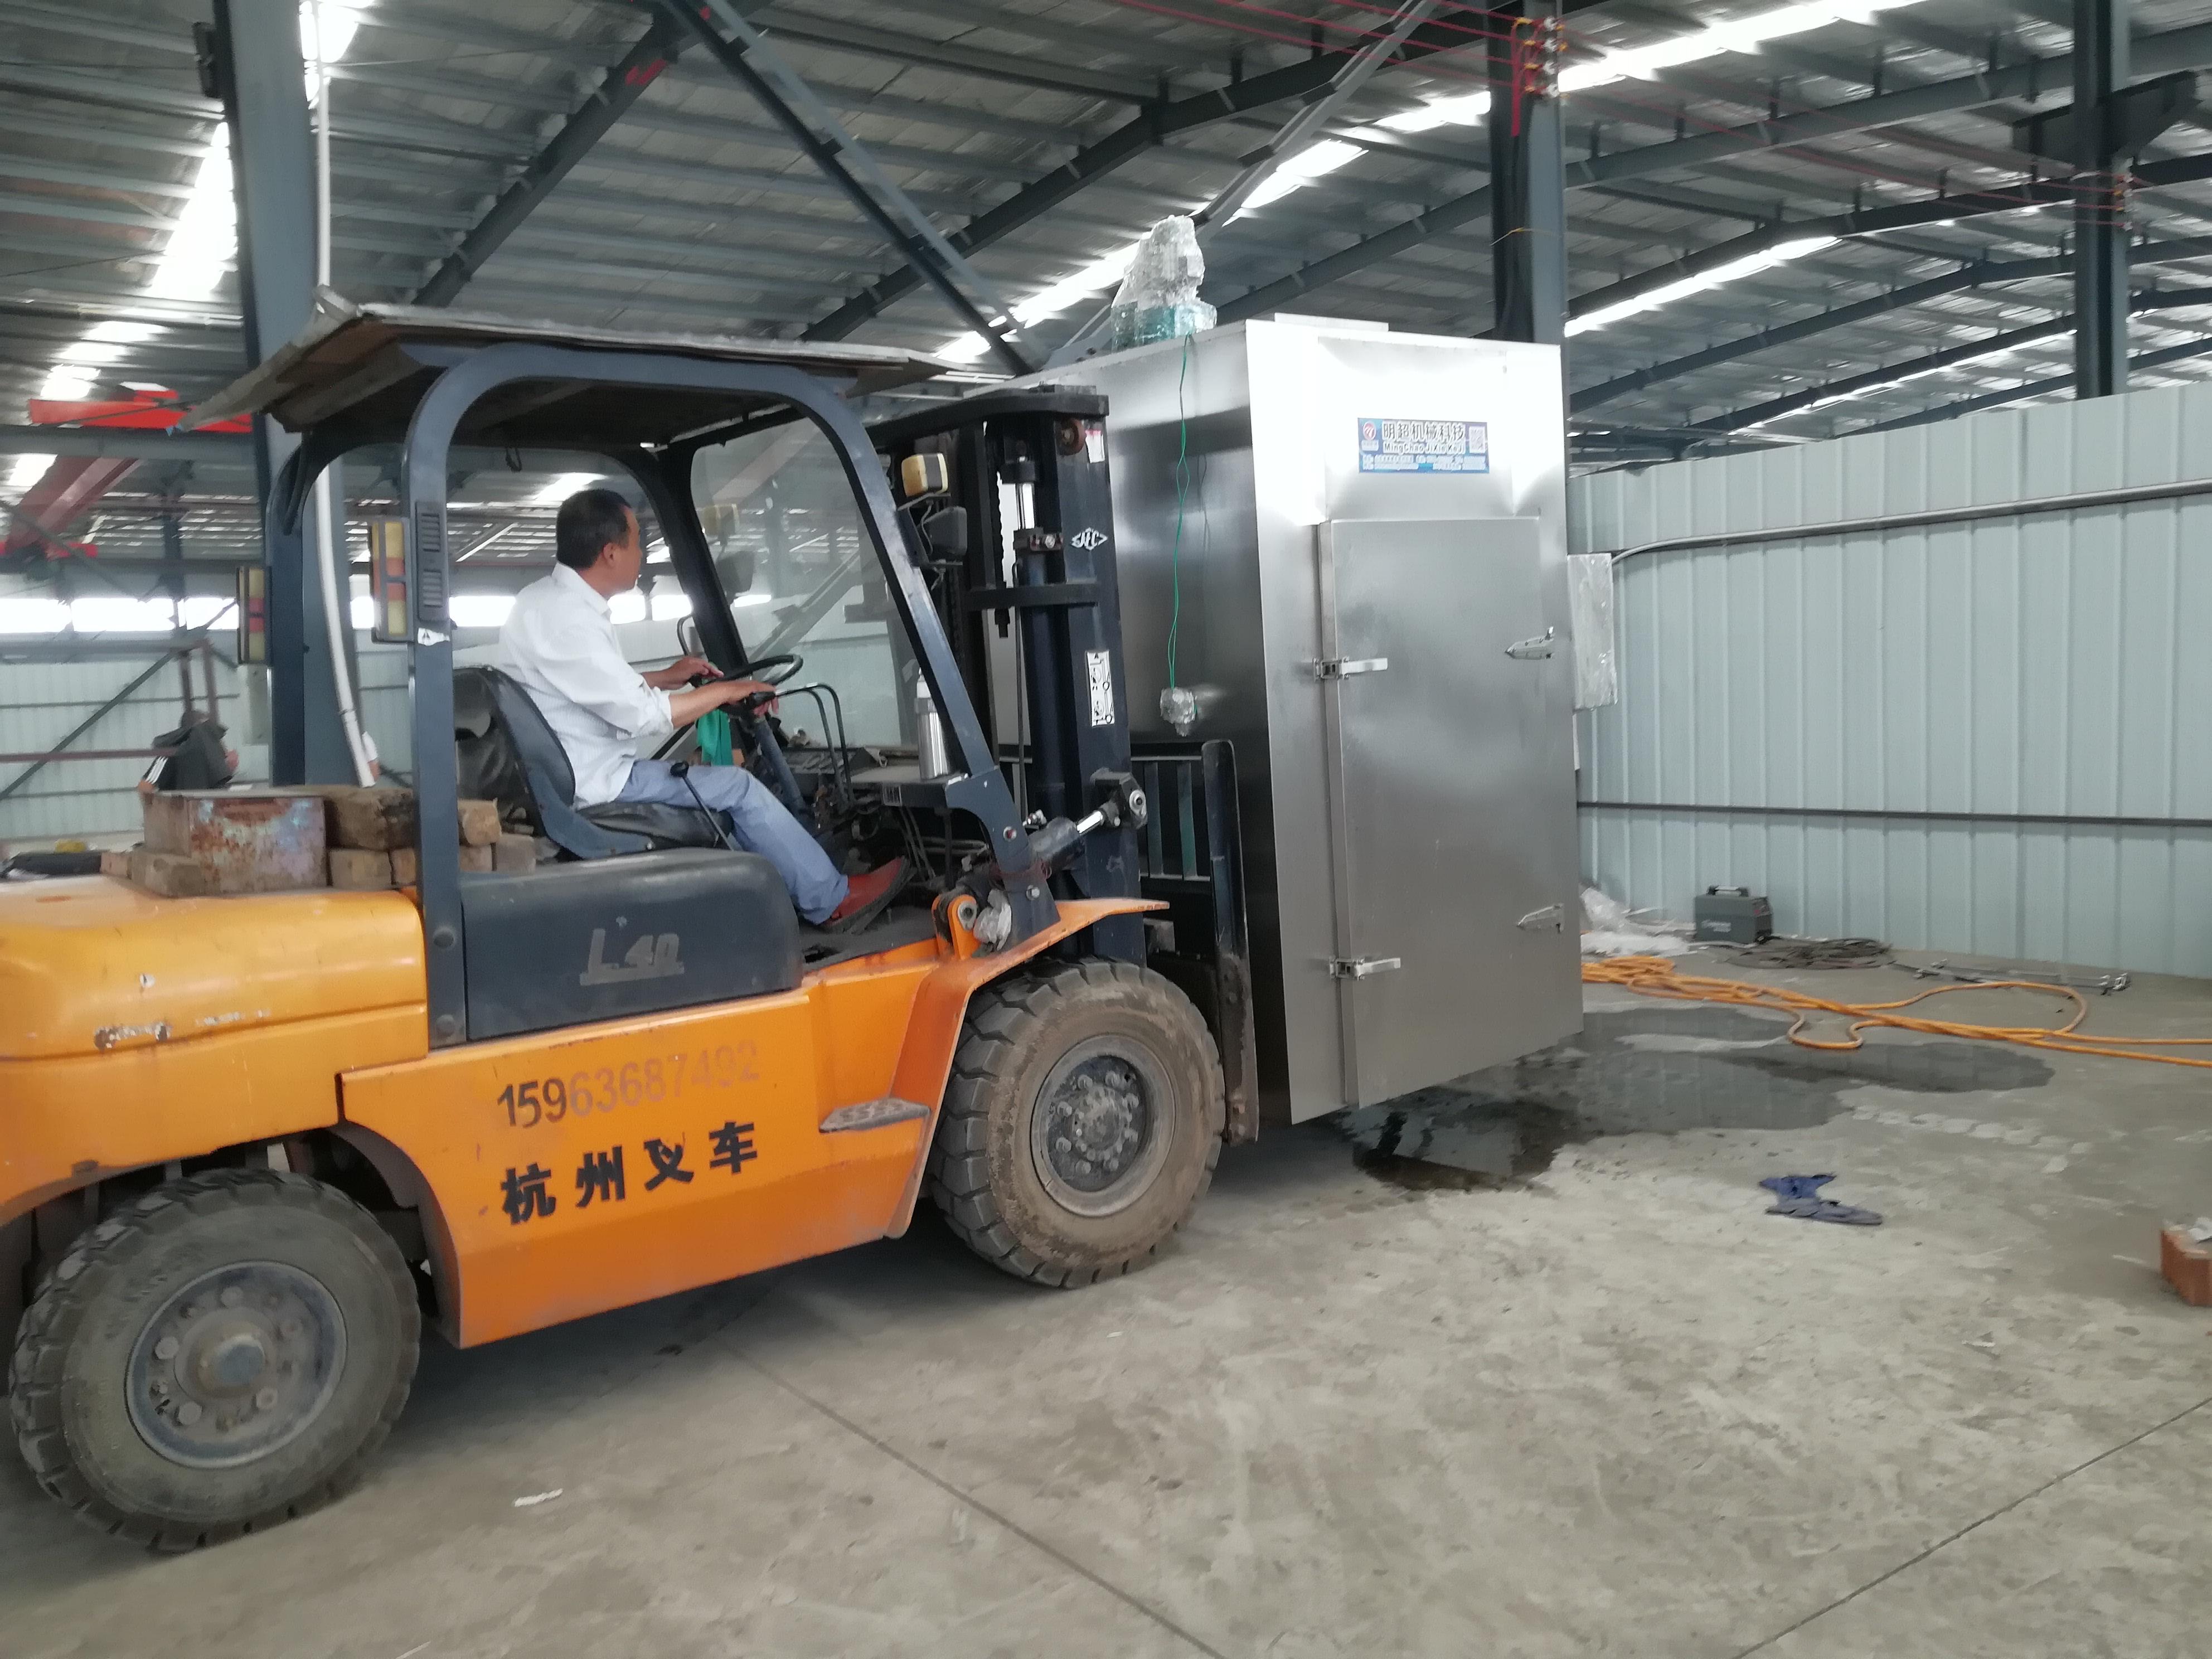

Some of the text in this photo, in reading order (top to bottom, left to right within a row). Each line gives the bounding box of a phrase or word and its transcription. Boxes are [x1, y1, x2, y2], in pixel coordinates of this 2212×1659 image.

[1382, 422, 1464, 442] 明超机械科技
[501, 1120, 758, 1225] 杭州叉车
